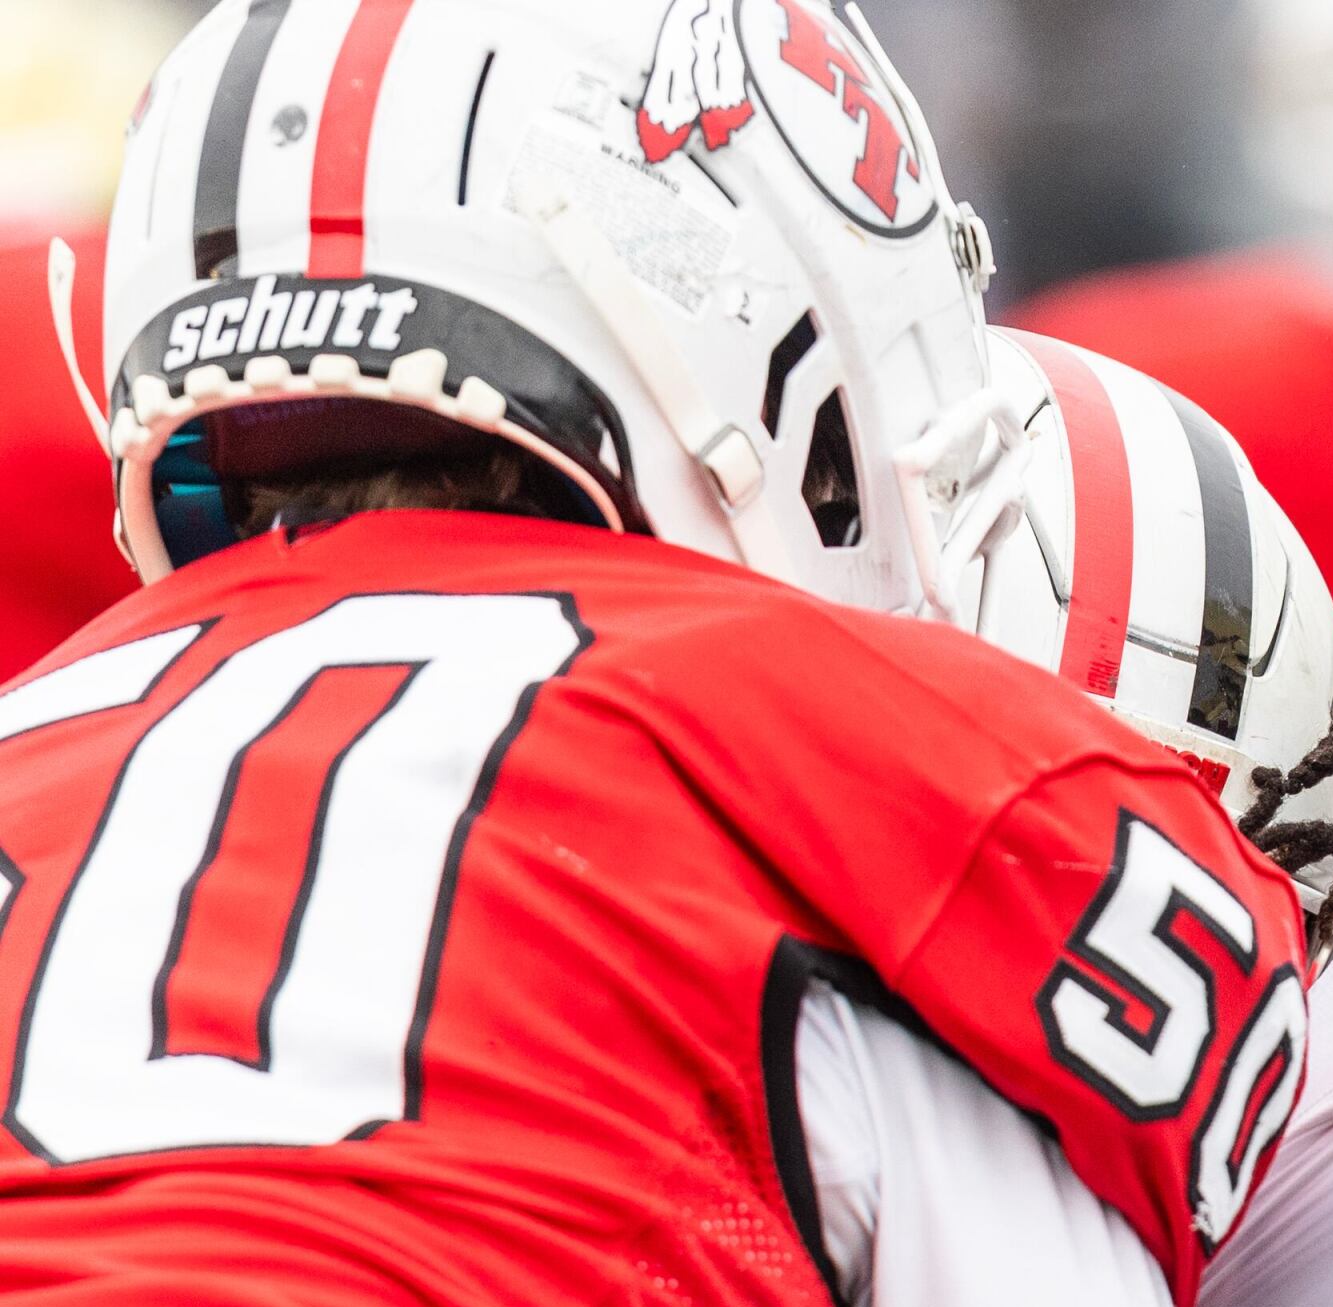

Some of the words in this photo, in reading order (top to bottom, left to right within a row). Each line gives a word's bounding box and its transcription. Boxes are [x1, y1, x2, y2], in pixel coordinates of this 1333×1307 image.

[163, 275, 417, 372] schutt
[0, 590, 596, 1166] 0
[1035, 805, 1310, 1258] 50
